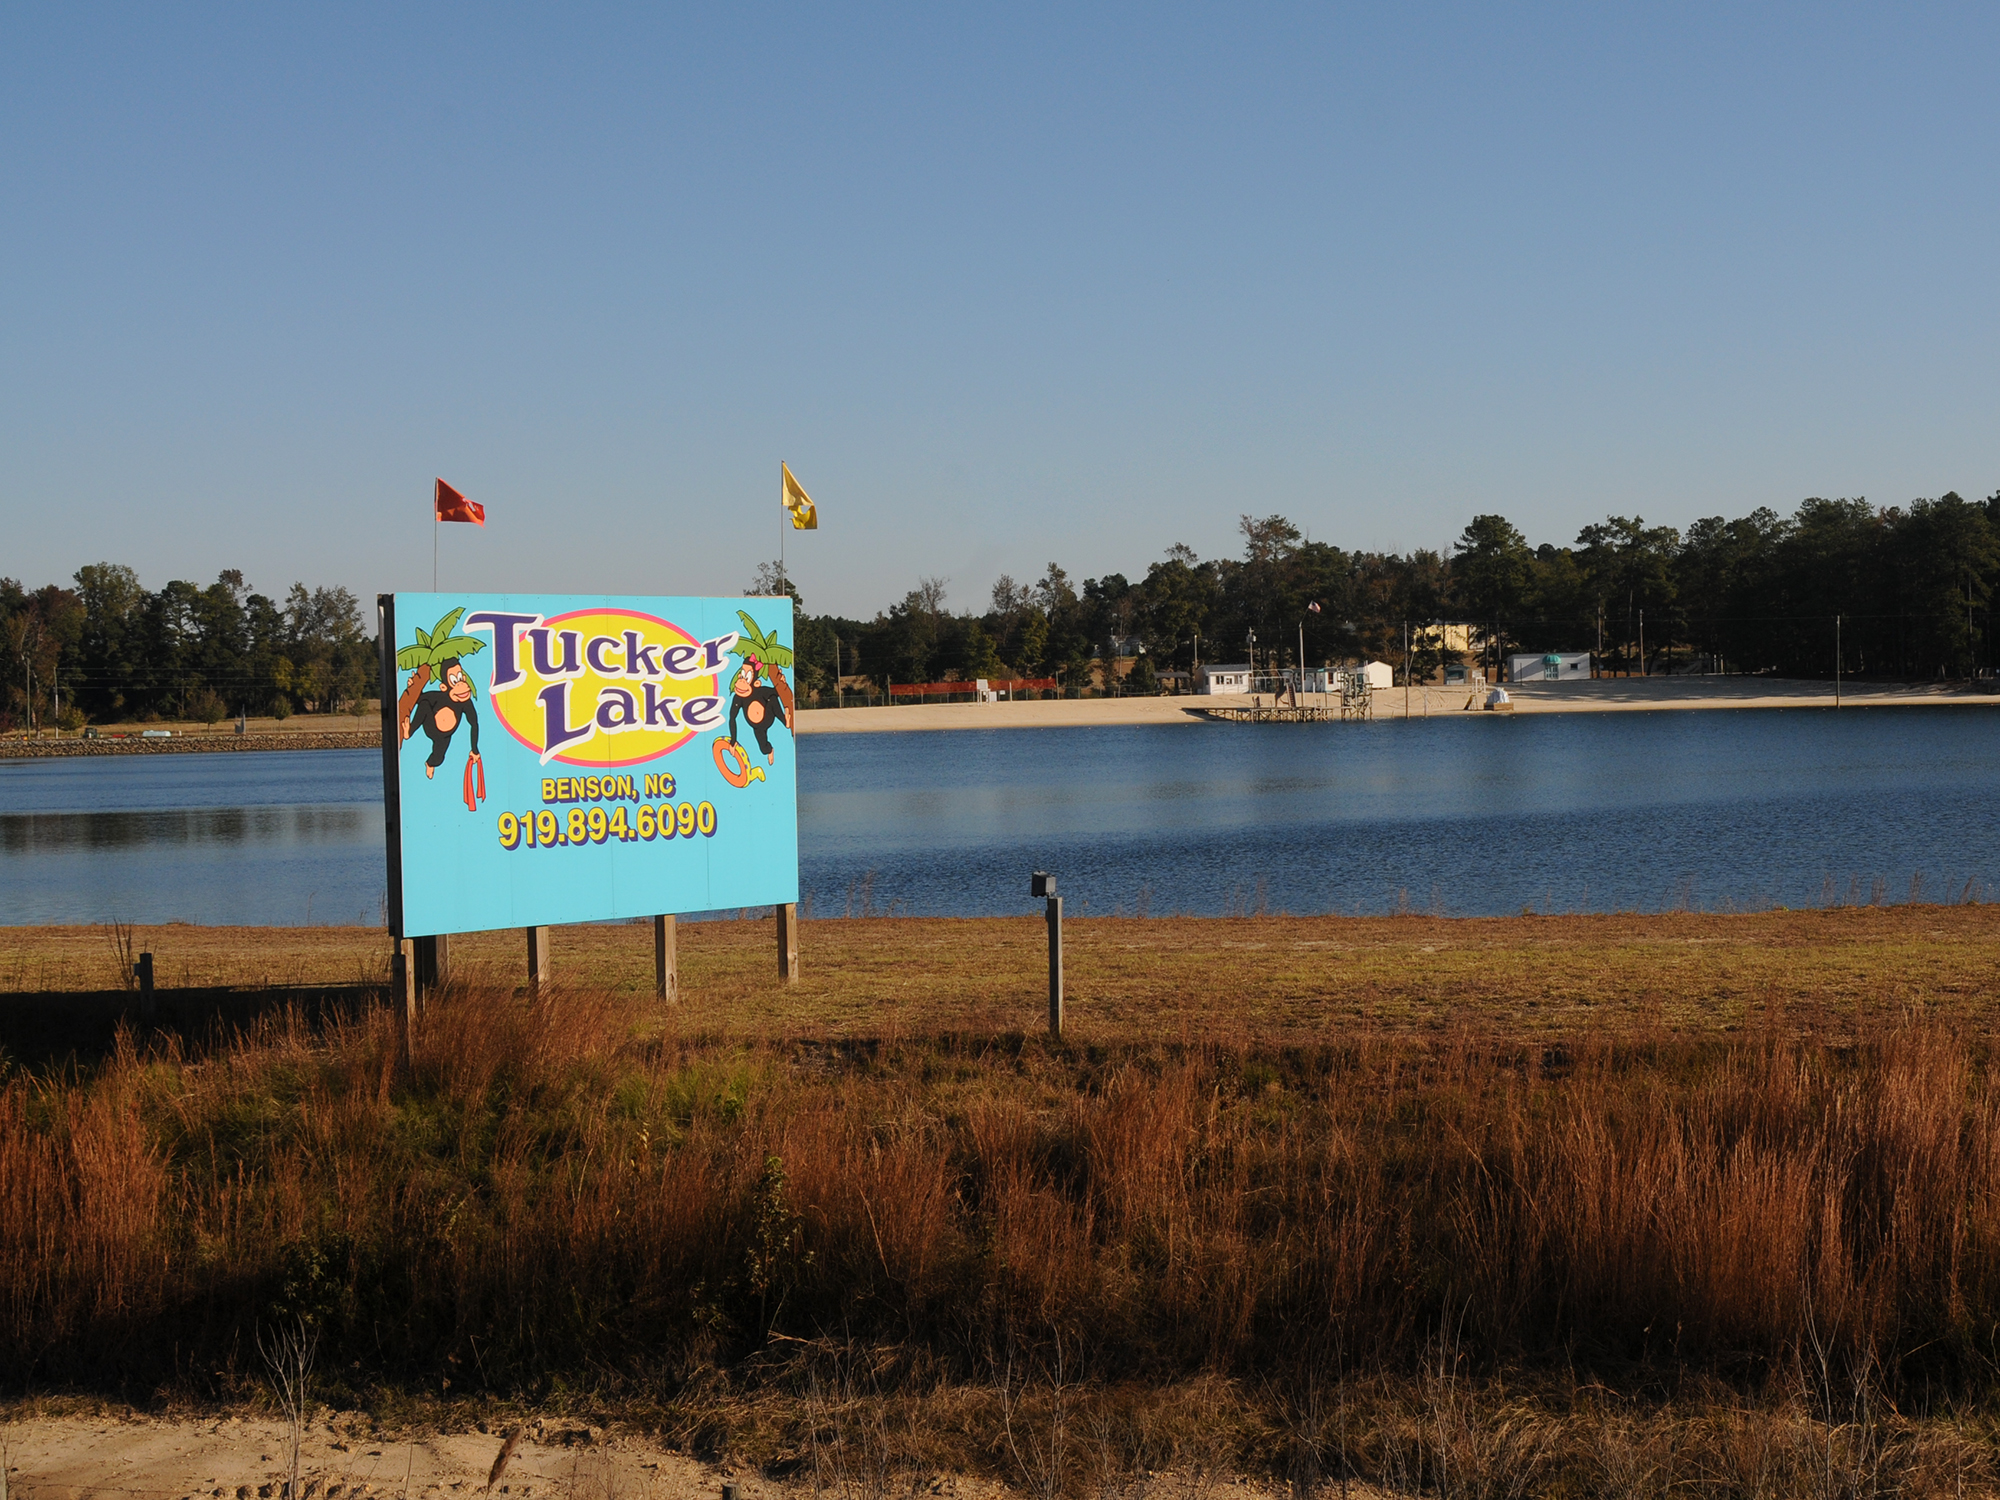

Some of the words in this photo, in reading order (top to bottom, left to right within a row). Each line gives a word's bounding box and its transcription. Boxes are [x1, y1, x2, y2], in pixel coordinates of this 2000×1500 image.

[464, 611, 739, 694] Tucker
[535, 680, 726, 767] Lake
[541, 775, 637, 804] BENSON,
[643, 772, 676, 799] NC
[498, 801, 717, 850] 919.894.6090
